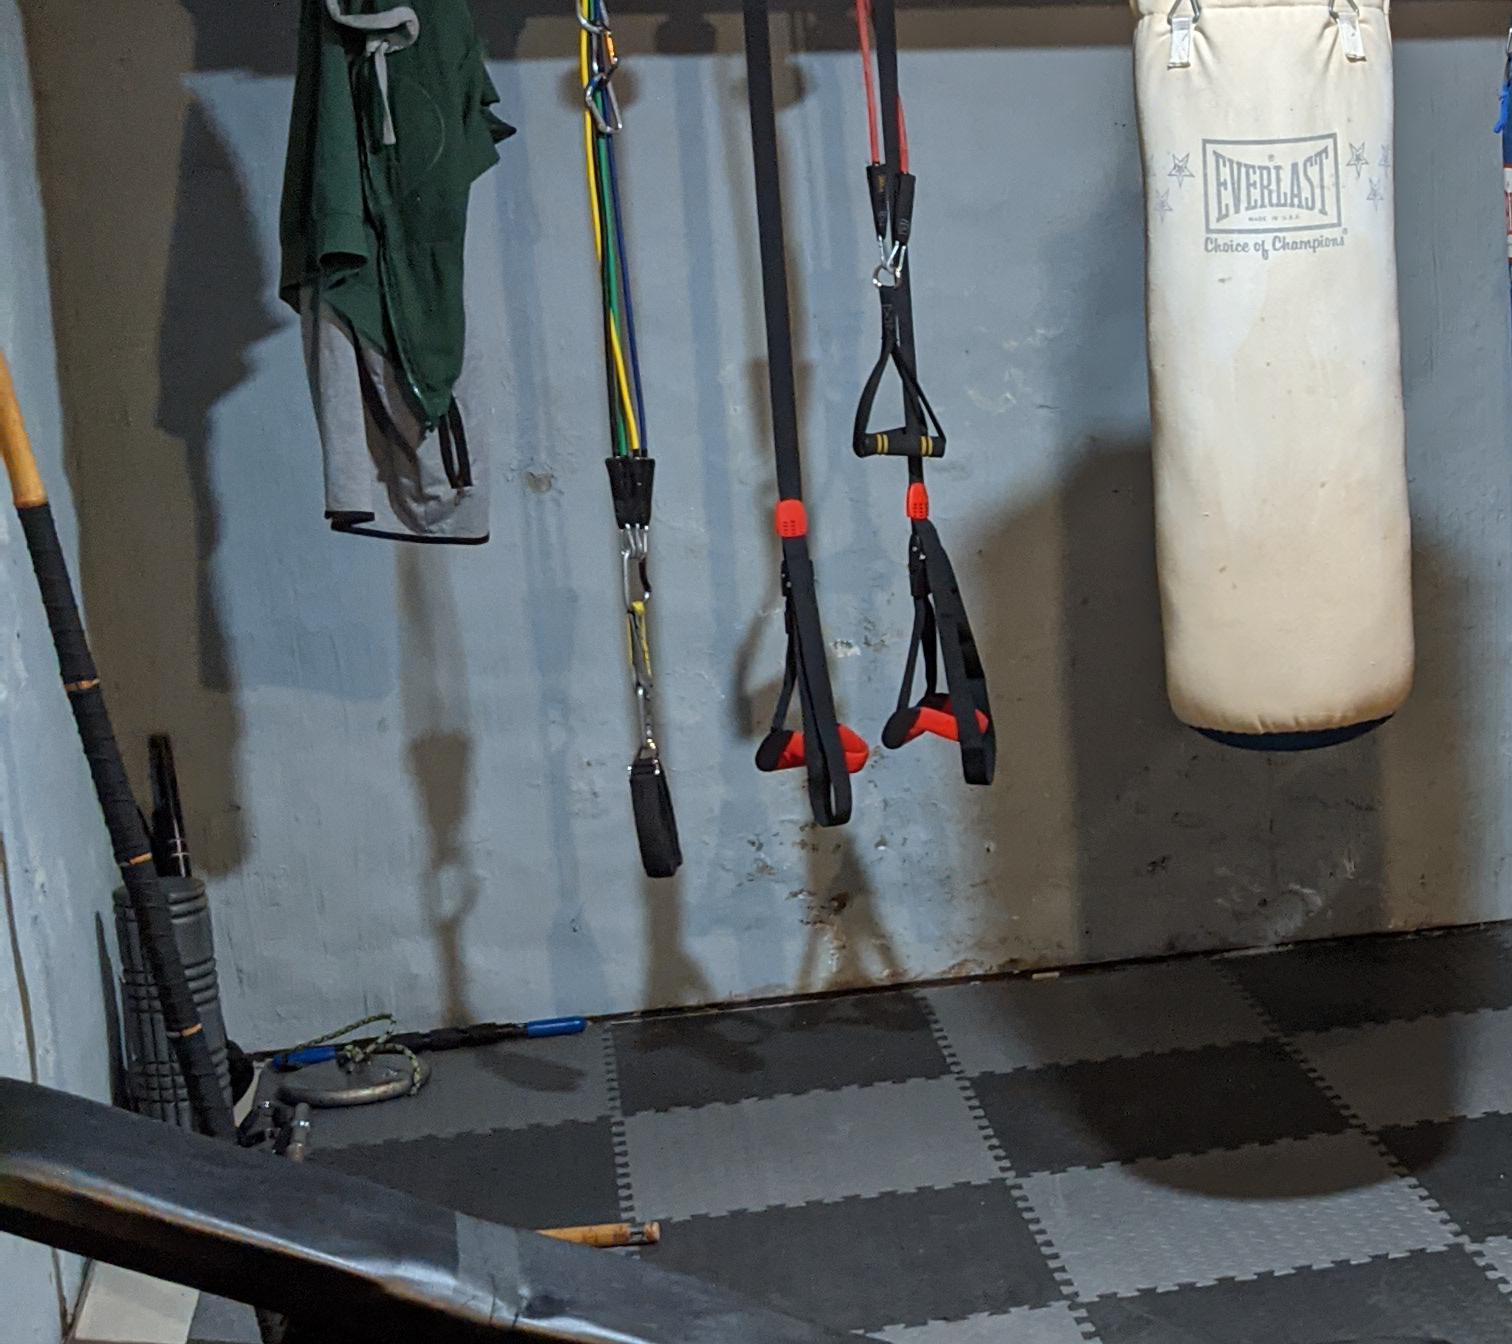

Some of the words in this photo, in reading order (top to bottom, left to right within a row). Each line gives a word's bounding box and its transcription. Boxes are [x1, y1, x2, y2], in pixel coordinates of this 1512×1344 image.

[1212, 145, 1329, 223] EVERLAST
[1204, 236, 1250, 253] Choice
[1253, 240, 1270, 261] of
[1271, 234, 1345, 254] Champions
